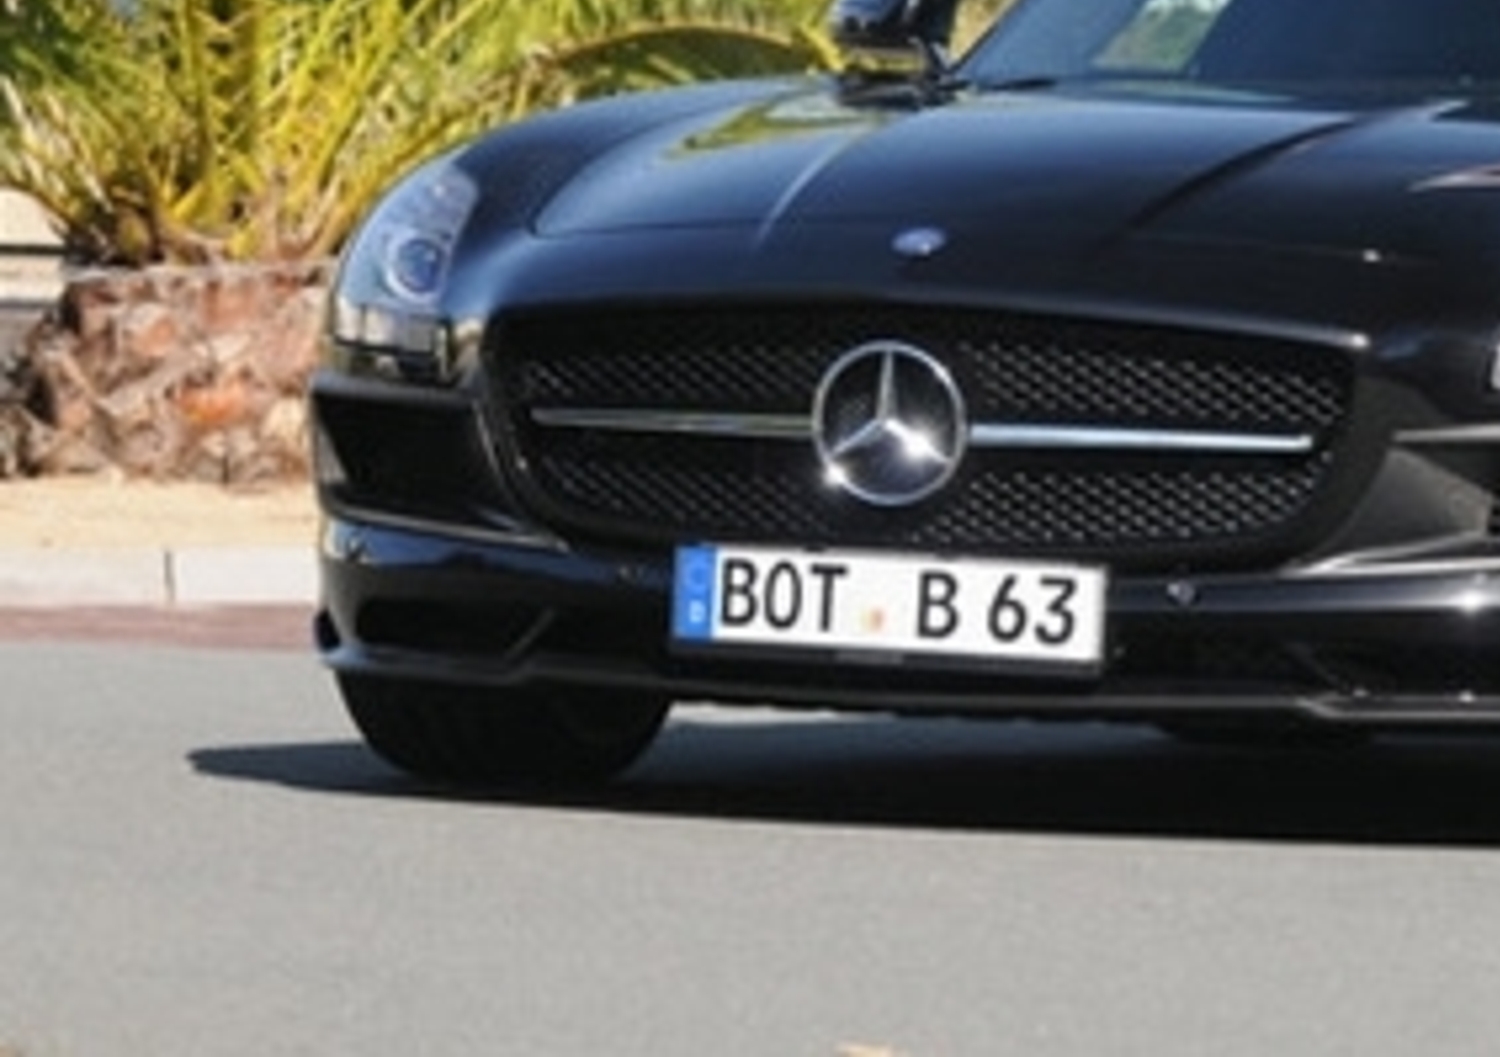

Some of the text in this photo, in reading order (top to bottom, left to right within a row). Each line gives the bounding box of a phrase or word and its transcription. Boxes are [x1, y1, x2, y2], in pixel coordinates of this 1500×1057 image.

[720, 558, 1077, 645] BOT B 63
